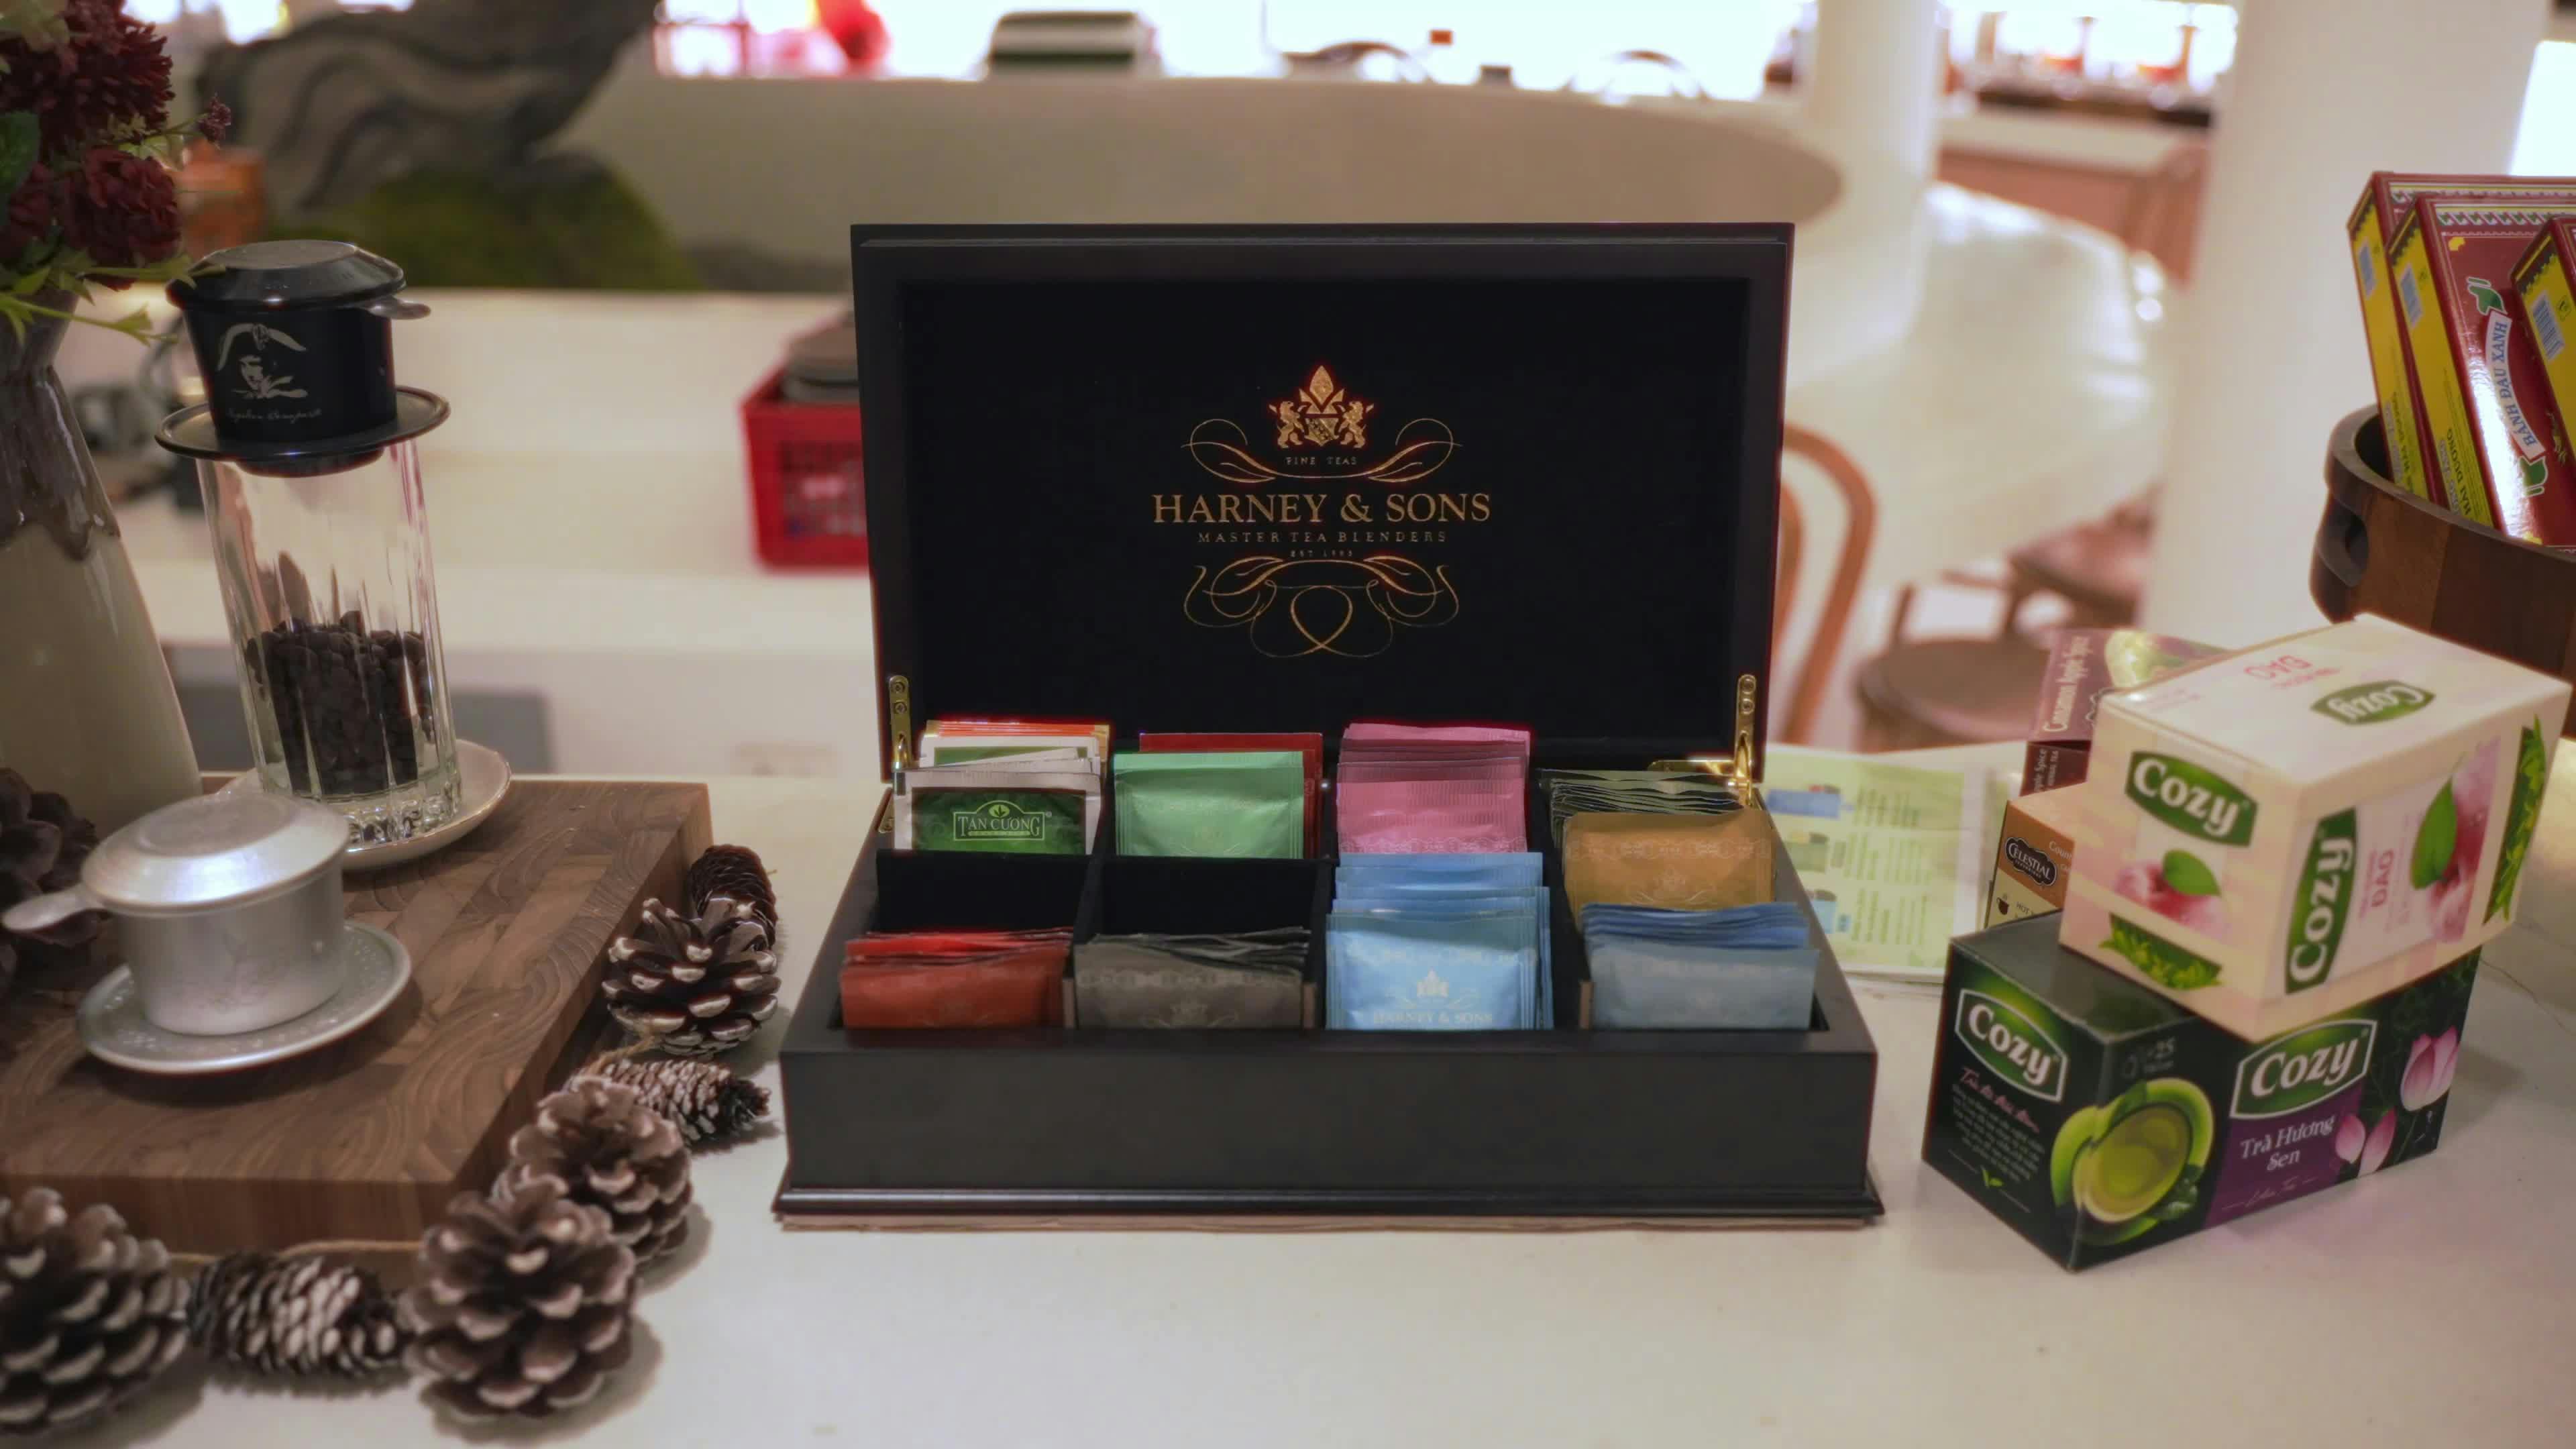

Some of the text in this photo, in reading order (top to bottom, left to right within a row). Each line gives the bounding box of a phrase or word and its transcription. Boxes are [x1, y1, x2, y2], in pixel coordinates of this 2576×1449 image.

[2491, 322, 2508, 363] XANH
[1286, 456, 1357, 466] FINE TEAS
[1152, 492, 1491, 523] HARNEY & SONS
[1197, 531, 1446, 543] MASTER TEA BLENDERS
[2328, 684, 2426, 722] Cozy
[2133, 758, 2239, 837] Cozy
[2008, 843, 2051, 881] CELESTIAL
[2290, 837, 2354, 982] Cozy
[1968, 1004, 2051, 1086] Cozy
[2251, 1038, 2359, 1097] Cozy
[2267, 1149, 2301, 1171] Sen
